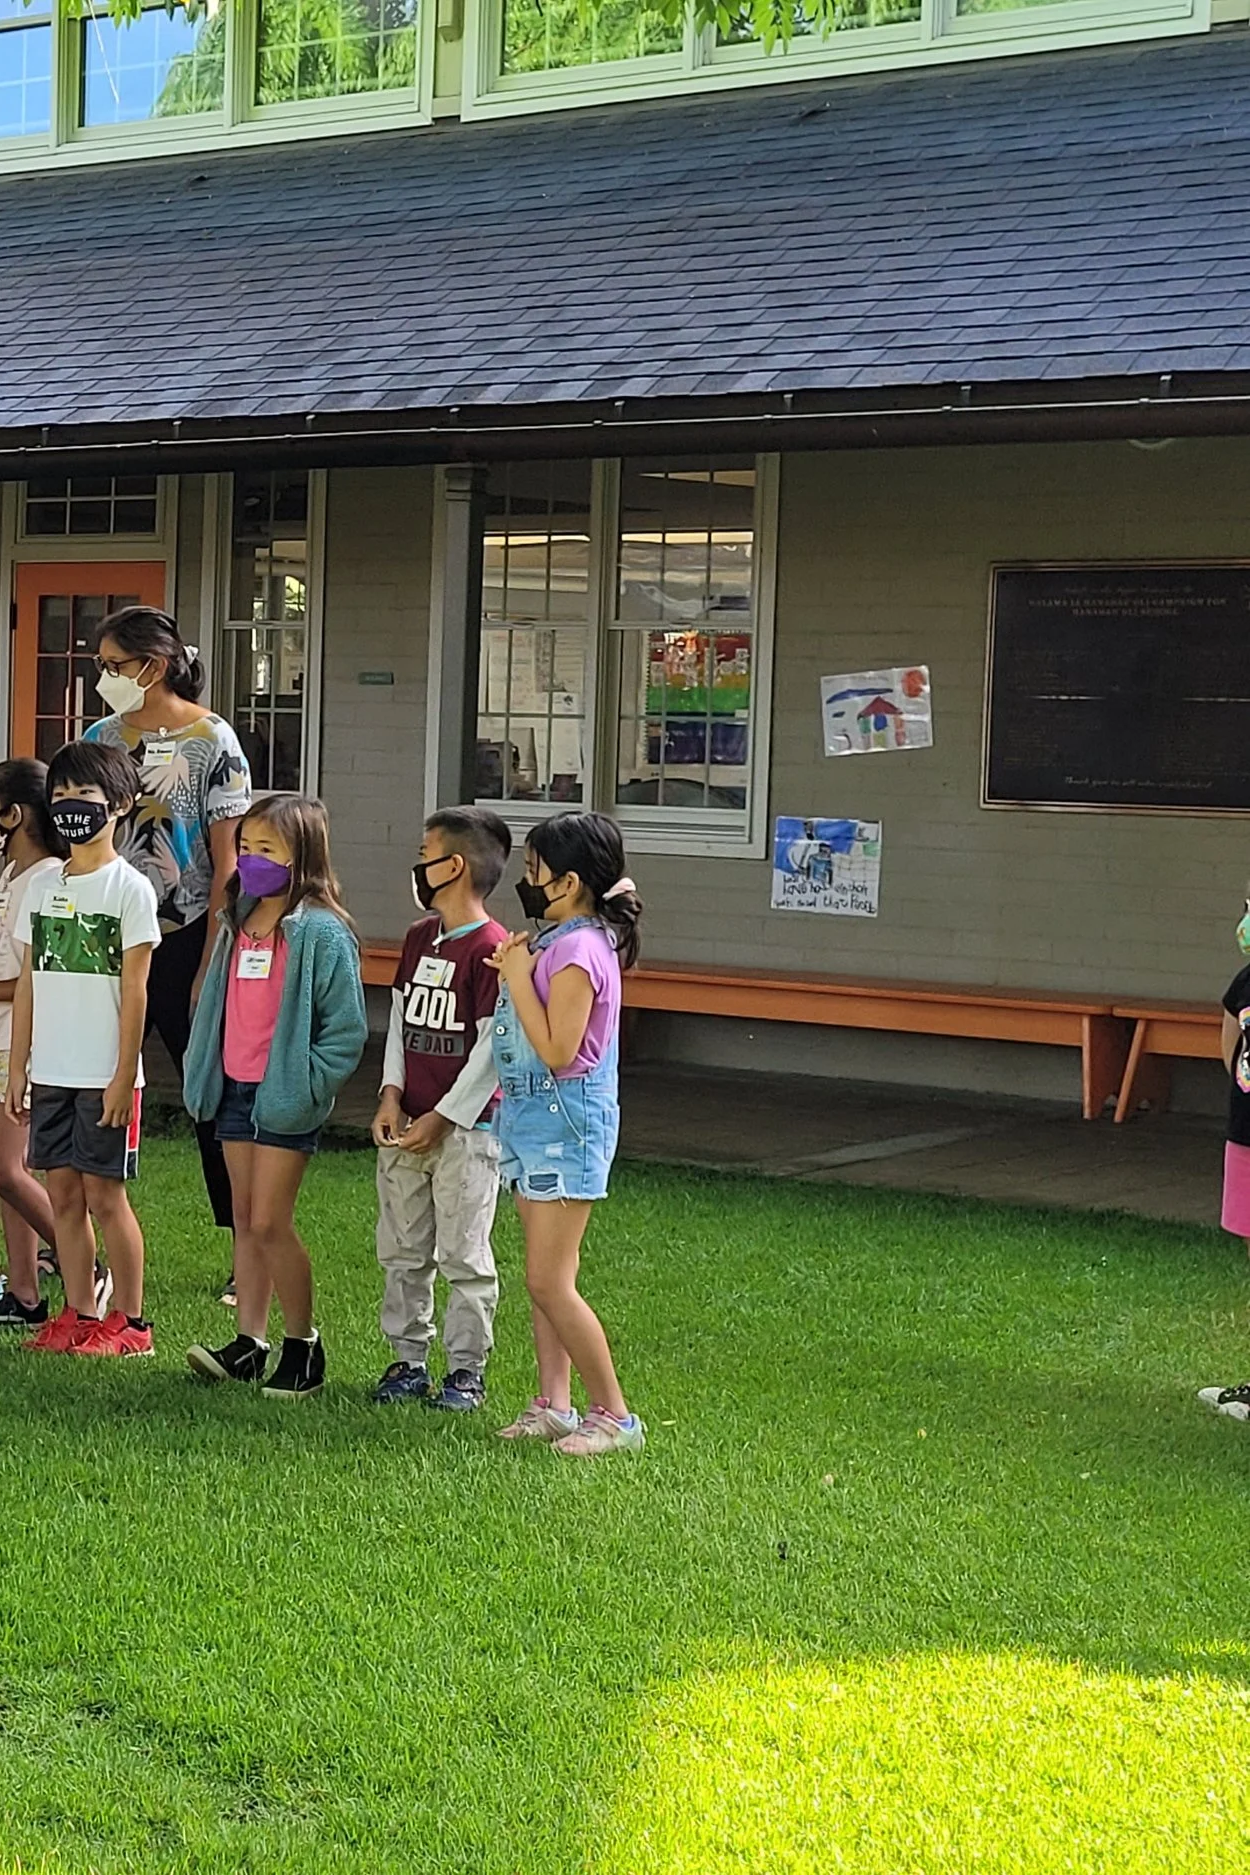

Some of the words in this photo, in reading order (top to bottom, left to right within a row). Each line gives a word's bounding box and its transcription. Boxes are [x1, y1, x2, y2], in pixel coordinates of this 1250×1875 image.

[65, 814, 92, 825] THE
[403, 982, 466, 1032] OOL
[424, 1034, 454, 1055] DAD
